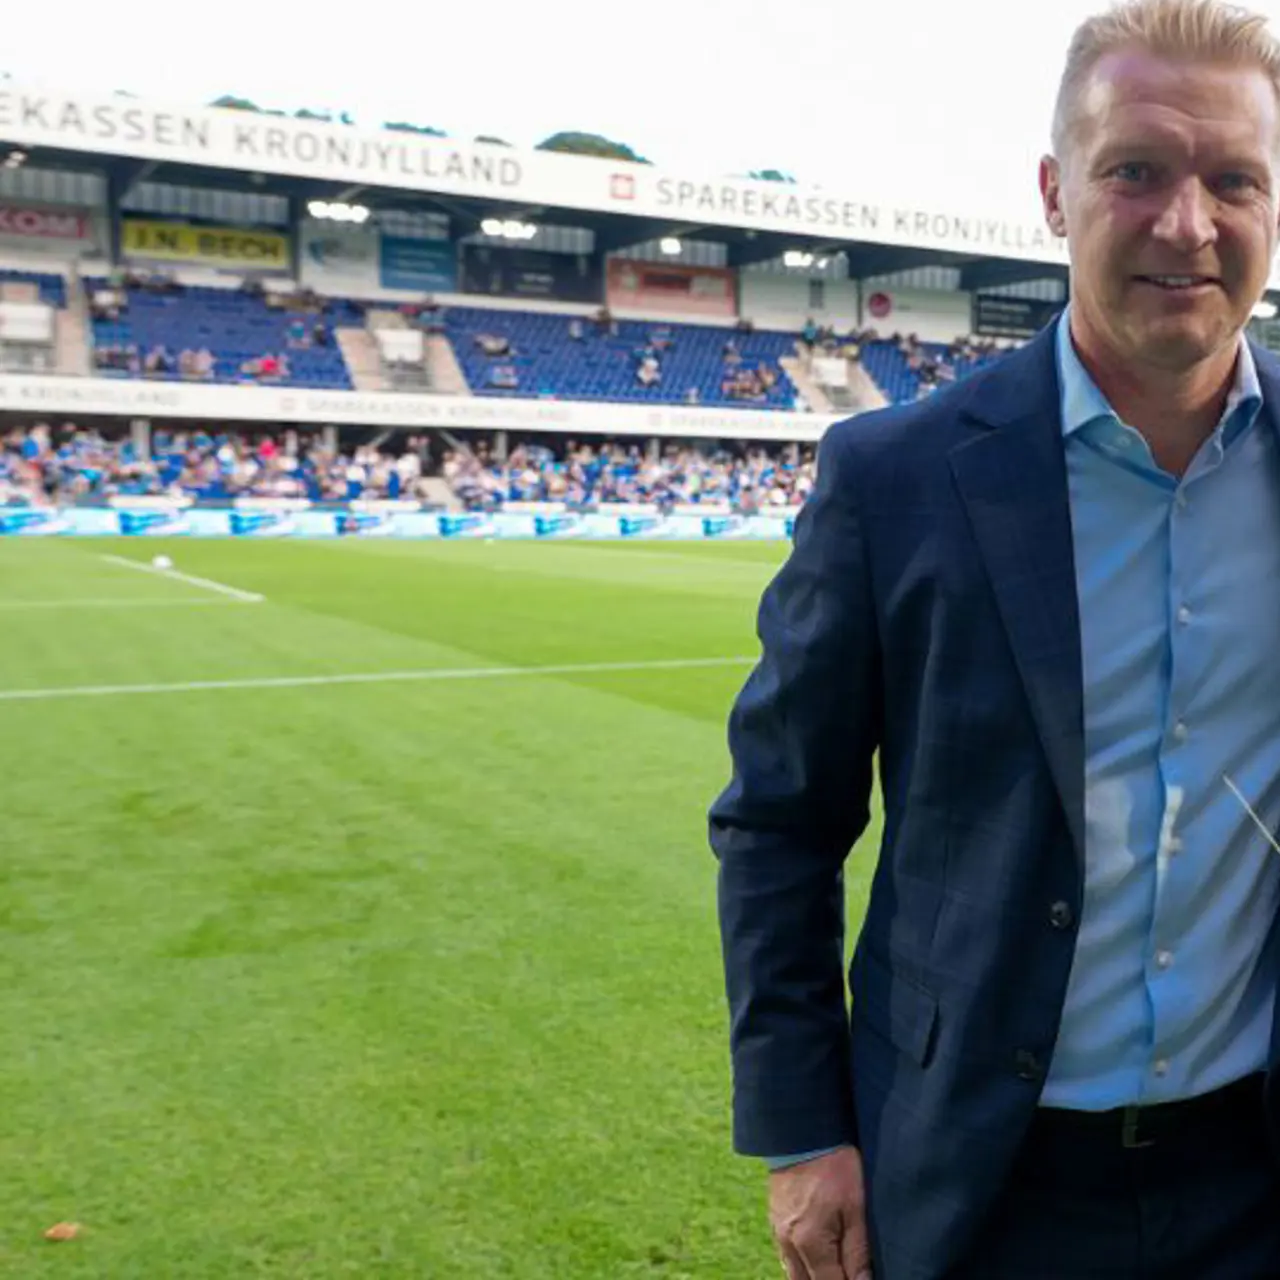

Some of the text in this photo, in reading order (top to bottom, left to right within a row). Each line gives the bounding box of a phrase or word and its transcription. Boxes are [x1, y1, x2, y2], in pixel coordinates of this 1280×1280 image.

[232, 123, 523, 188] KRONJYLLAND
[656, 178, 1064, 252] SPAREKASSEN KRONJYLLA
